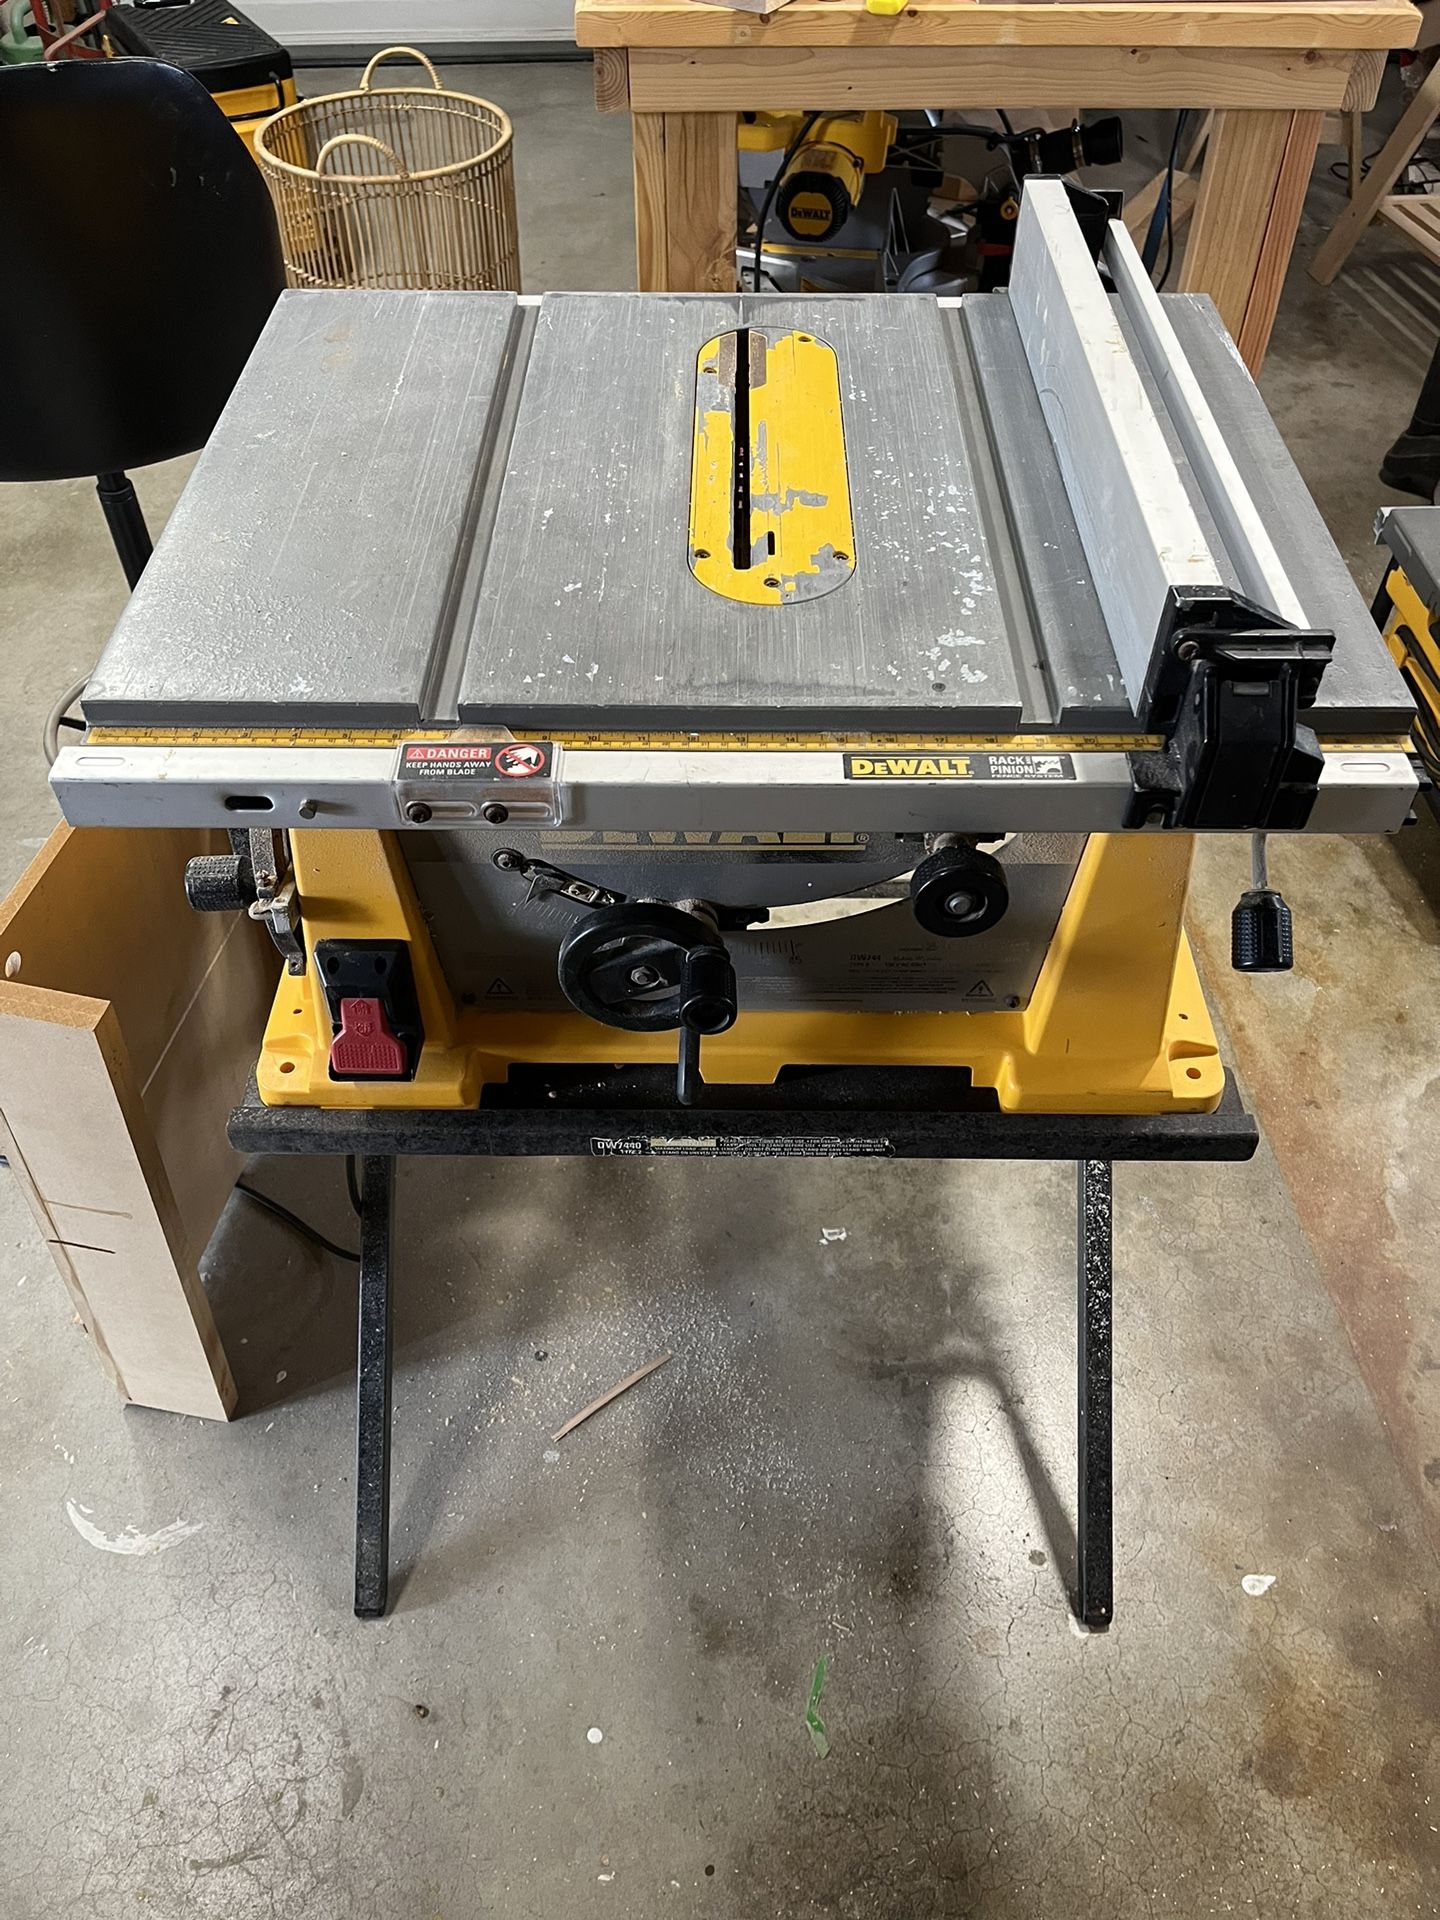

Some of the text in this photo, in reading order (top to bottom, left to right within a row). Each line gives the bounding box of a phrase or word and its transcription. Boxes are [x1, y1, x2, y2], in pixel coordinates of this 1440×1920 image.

[427, 749, 488, 759] DANGER
[988, 755, 1025, 765] RACK
[430, 761, 462, 769] HANDS
[851, 758, 971, 775] DEWALT
[990, 765, 1034, 774] PINION
[597, 1141, 642, 1149] DW7440
